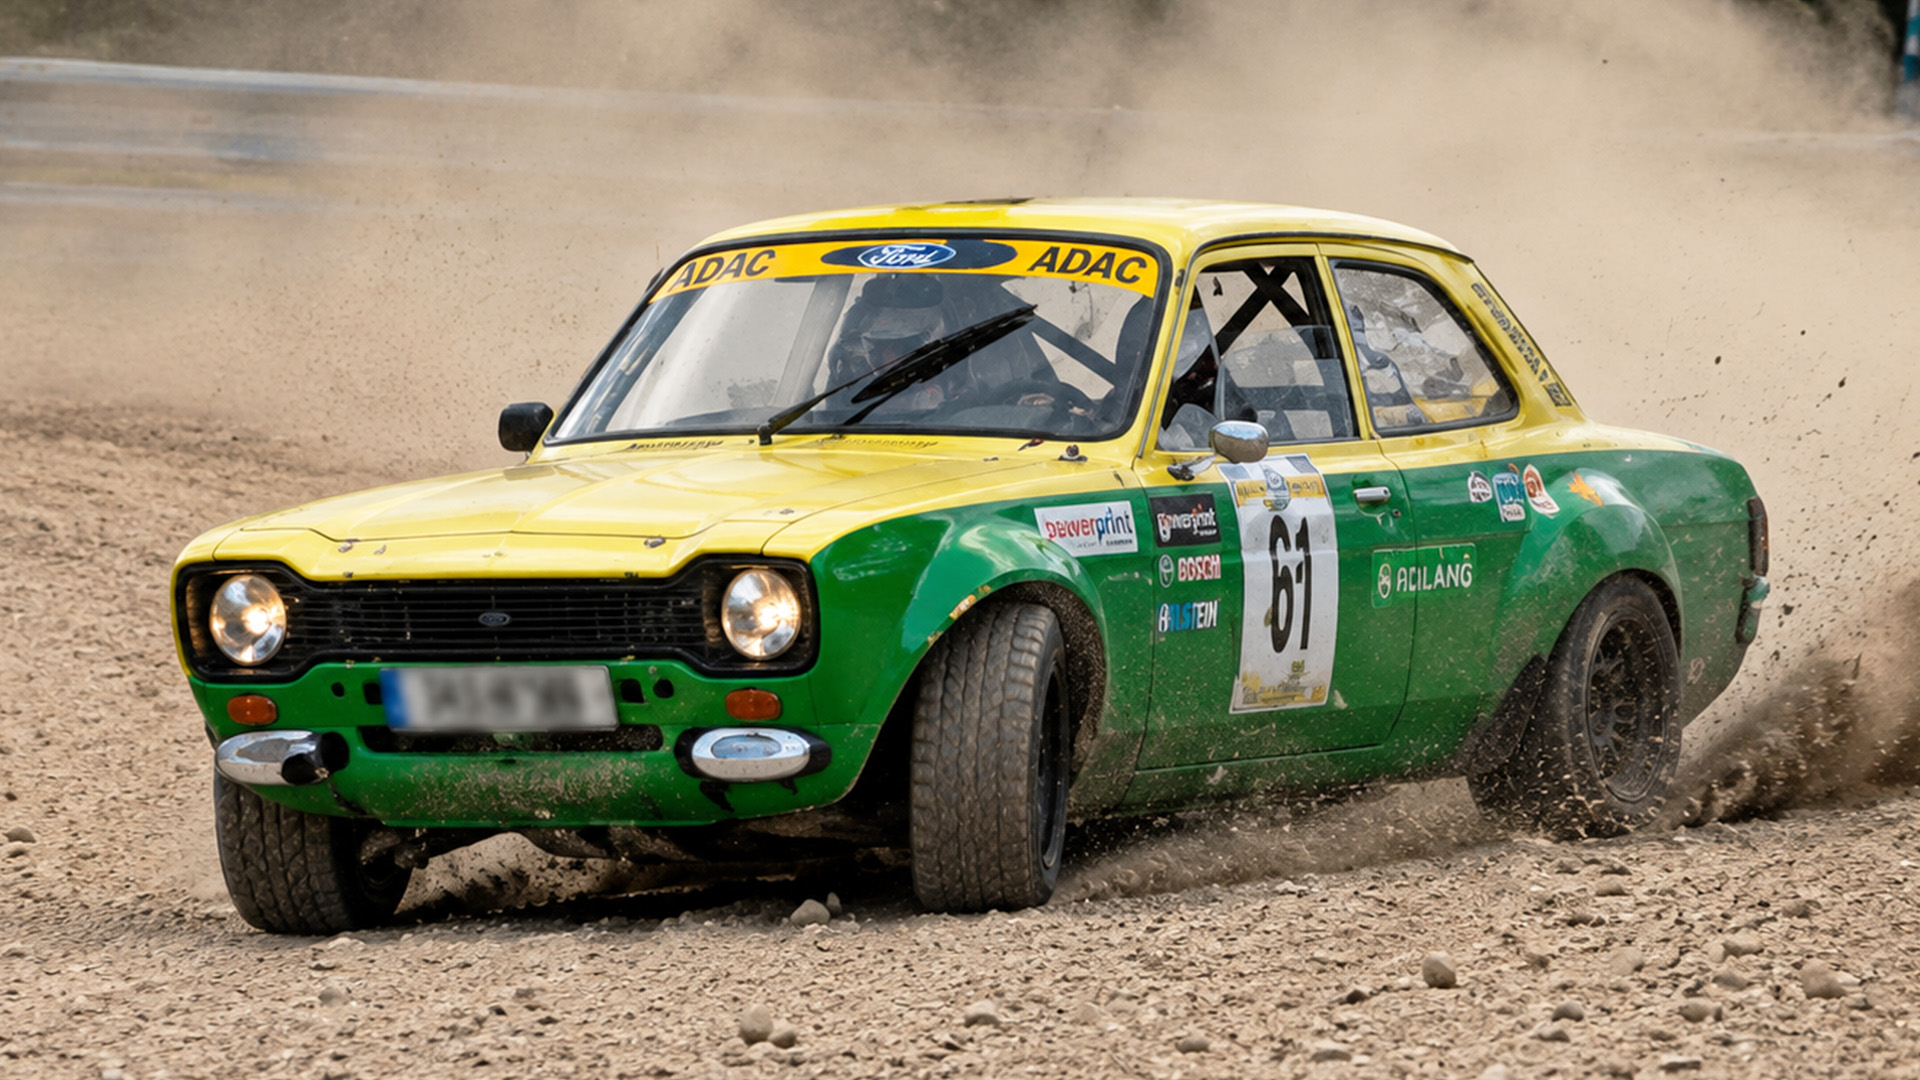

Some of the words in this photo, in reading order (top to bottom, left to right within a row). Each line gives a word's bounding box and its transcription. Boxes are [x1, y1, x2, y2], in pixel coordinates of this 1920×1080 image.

[667, 249, 776, 293] ADAC
[868, 244, 940, 266] Ford
[1027, 246, 1148, 285] ADAC
[1269, 514, 1312, 654] 61
